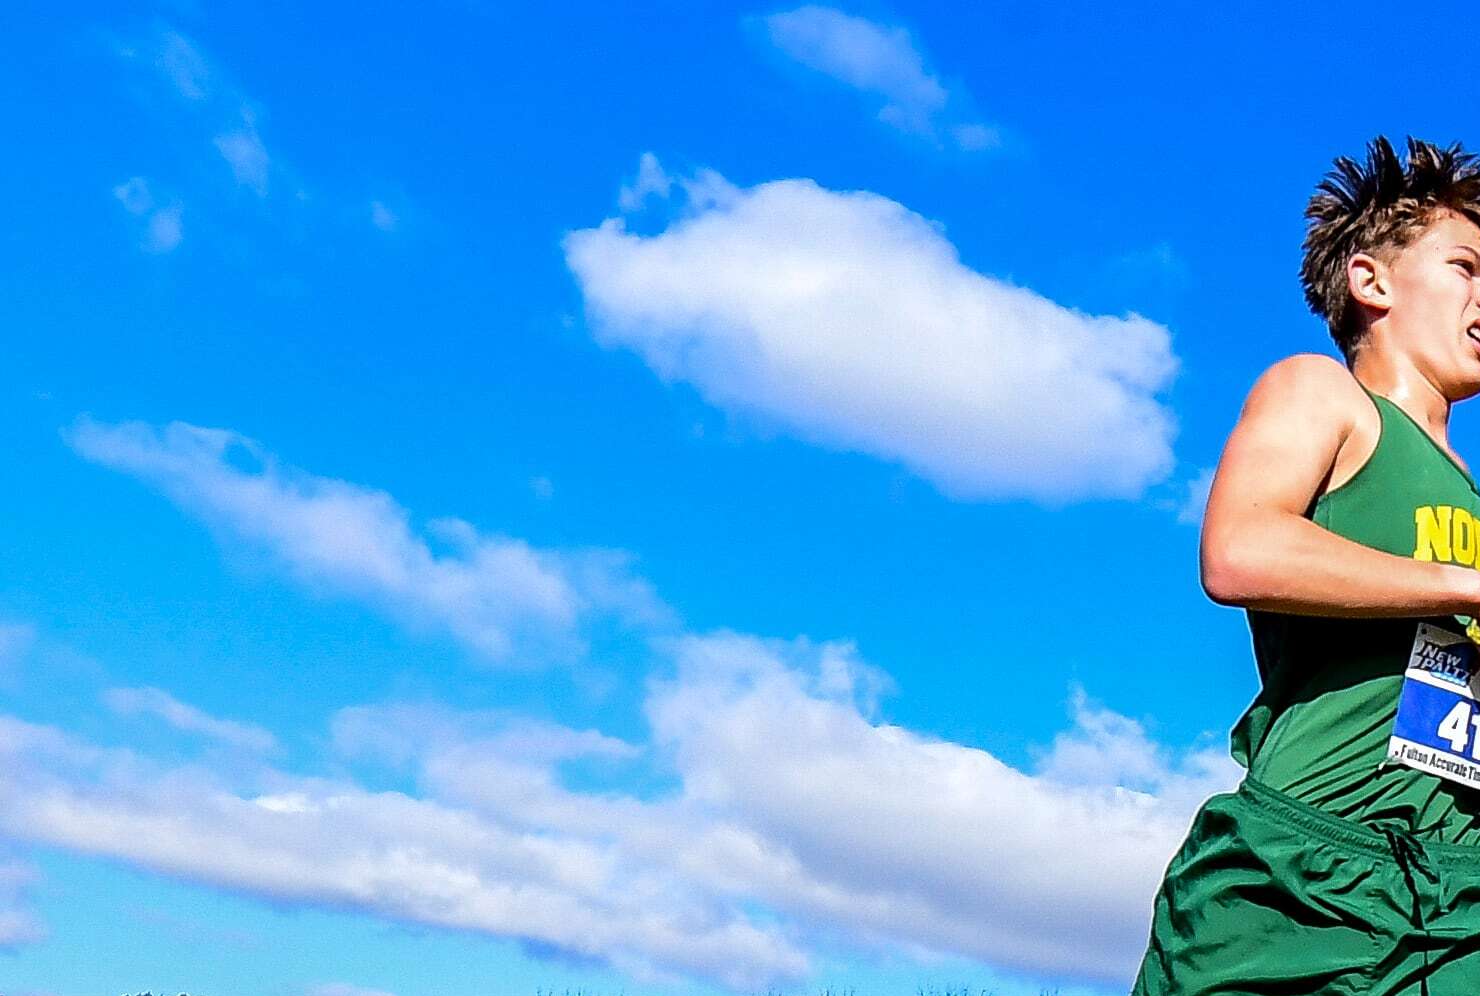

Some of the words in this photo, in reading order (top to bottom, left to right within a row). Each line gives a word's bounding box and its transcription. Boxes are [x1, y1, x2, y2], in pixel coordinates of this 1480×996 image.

[1421, 643, 1462, 666] NEW
[1420, 657, 1471, 681] PALTZ
[1400, 743, 1428, 765] Fulton
[1428, 752, 1468, 779] Accurate
